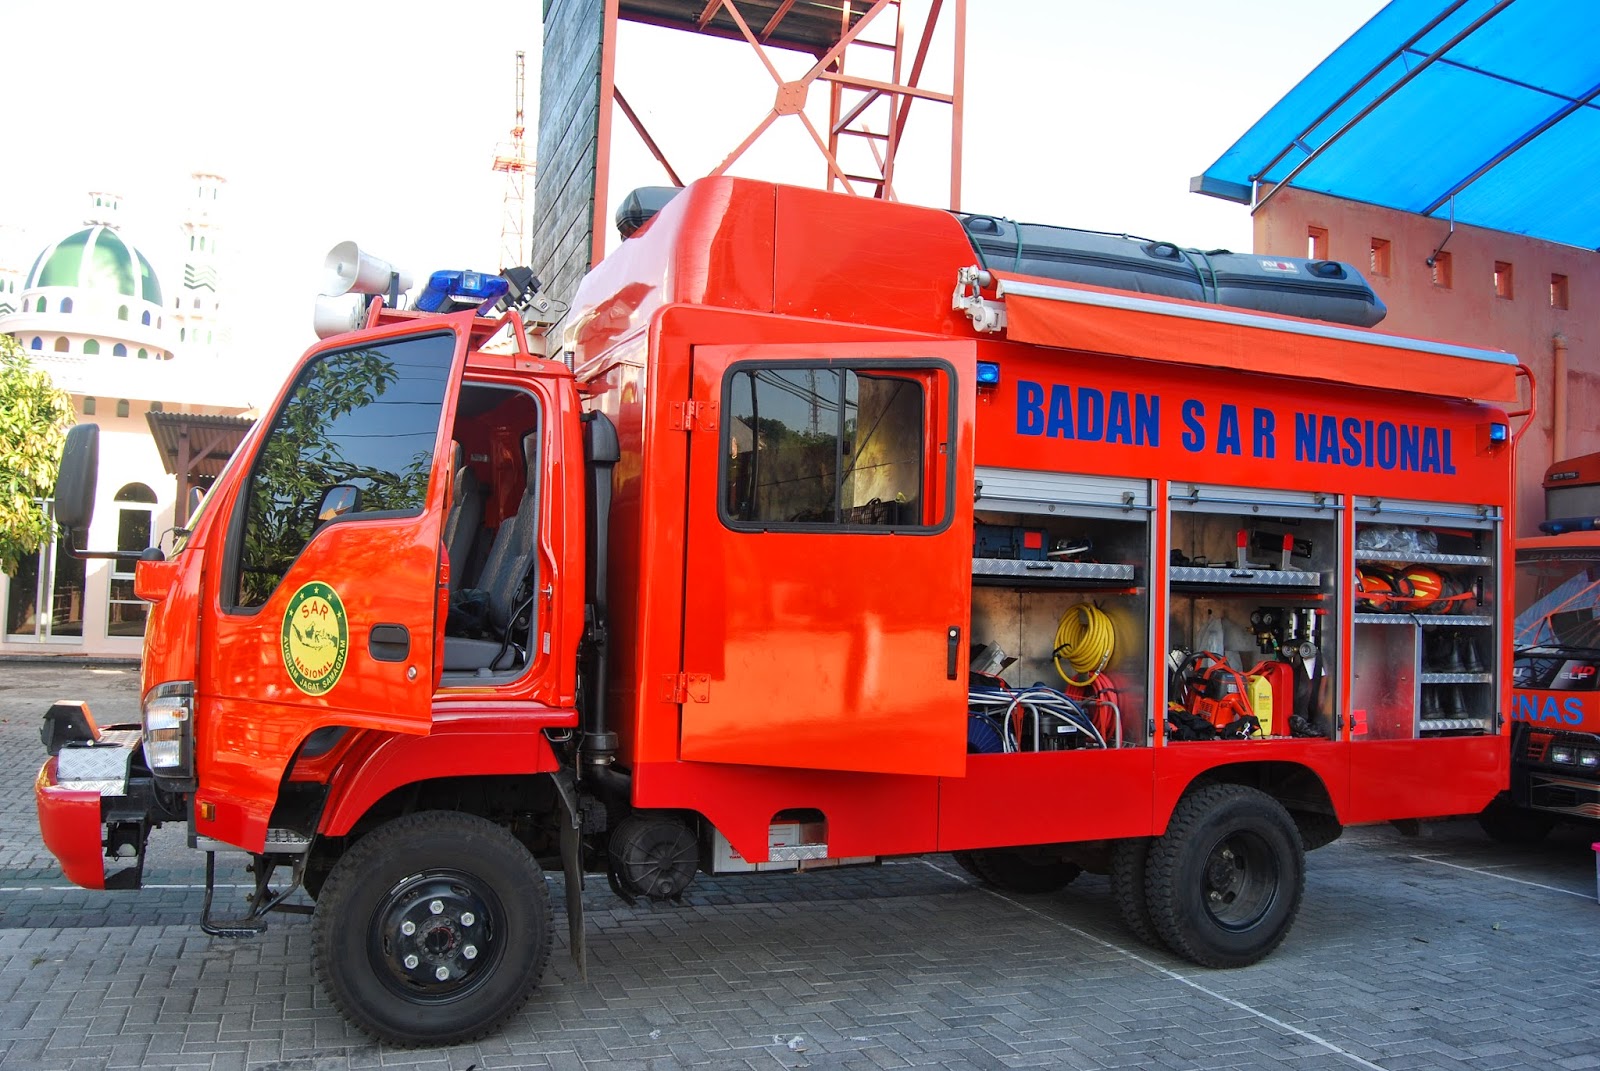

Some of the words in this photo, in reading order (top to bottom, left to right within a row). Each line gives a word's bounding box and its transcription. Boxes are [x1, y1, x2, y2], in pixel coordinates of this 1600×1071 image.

[1016, 380, 1160, 448] BADAN
[1295, 412, 1457, 476] NASIONAL
[301, 600, 329, 620] SAR
[283, 636, 299, 679] AVIGNAM
[299, 679, 320, 691] JAGAT
[322, 640, 346, 688] SAMAGRAM
[295, 657, 333, 679] NASIONAL
[1560, 672, 1588, 680] ELF
